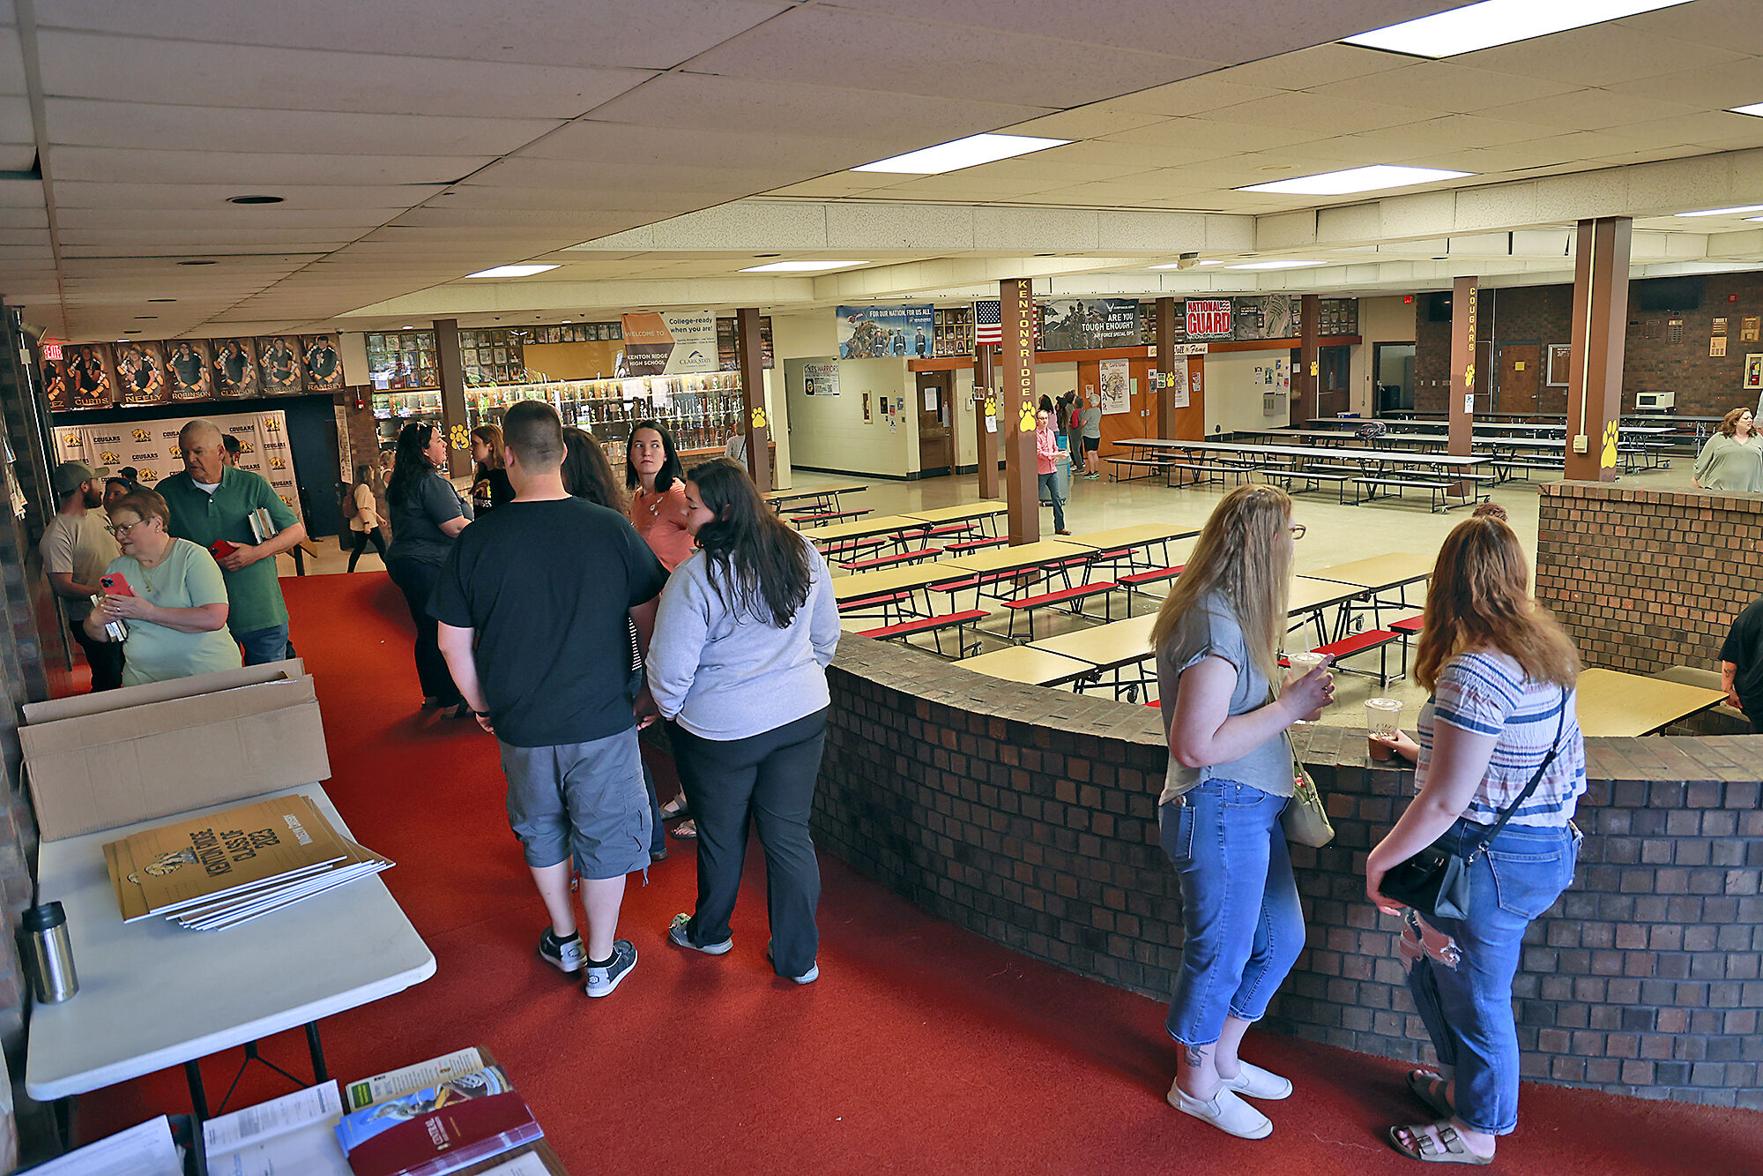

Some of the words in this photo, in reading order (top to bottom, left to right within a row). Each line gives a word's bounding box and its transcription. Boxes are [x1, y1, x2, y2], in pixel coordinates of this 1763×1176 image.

[1018, 280, 1028, 338] KENTON
[1187, 301, 1220, 312] NATIONAL
[669, 317, 712, 325] College-ready
[1107, 313, 1122, 321] ARE
[1123, 313, 1134, 321] YOU
[1468, 287, 1476, 351] COUGARS
[1081, 322, 1103, 331] TOUGH
[1105, 321, 1134, 330] ENOUGH?
[1187, 312, 1231, 334] GUARD
[689, 326, 701, 334] you
[1020, 349, 1031, 396] RIDGE
[307, 383, 342, 391] RAMSEY
[125, 394, 162, 402] NEELY
[172, 391, 211, 399] ROBINSON
